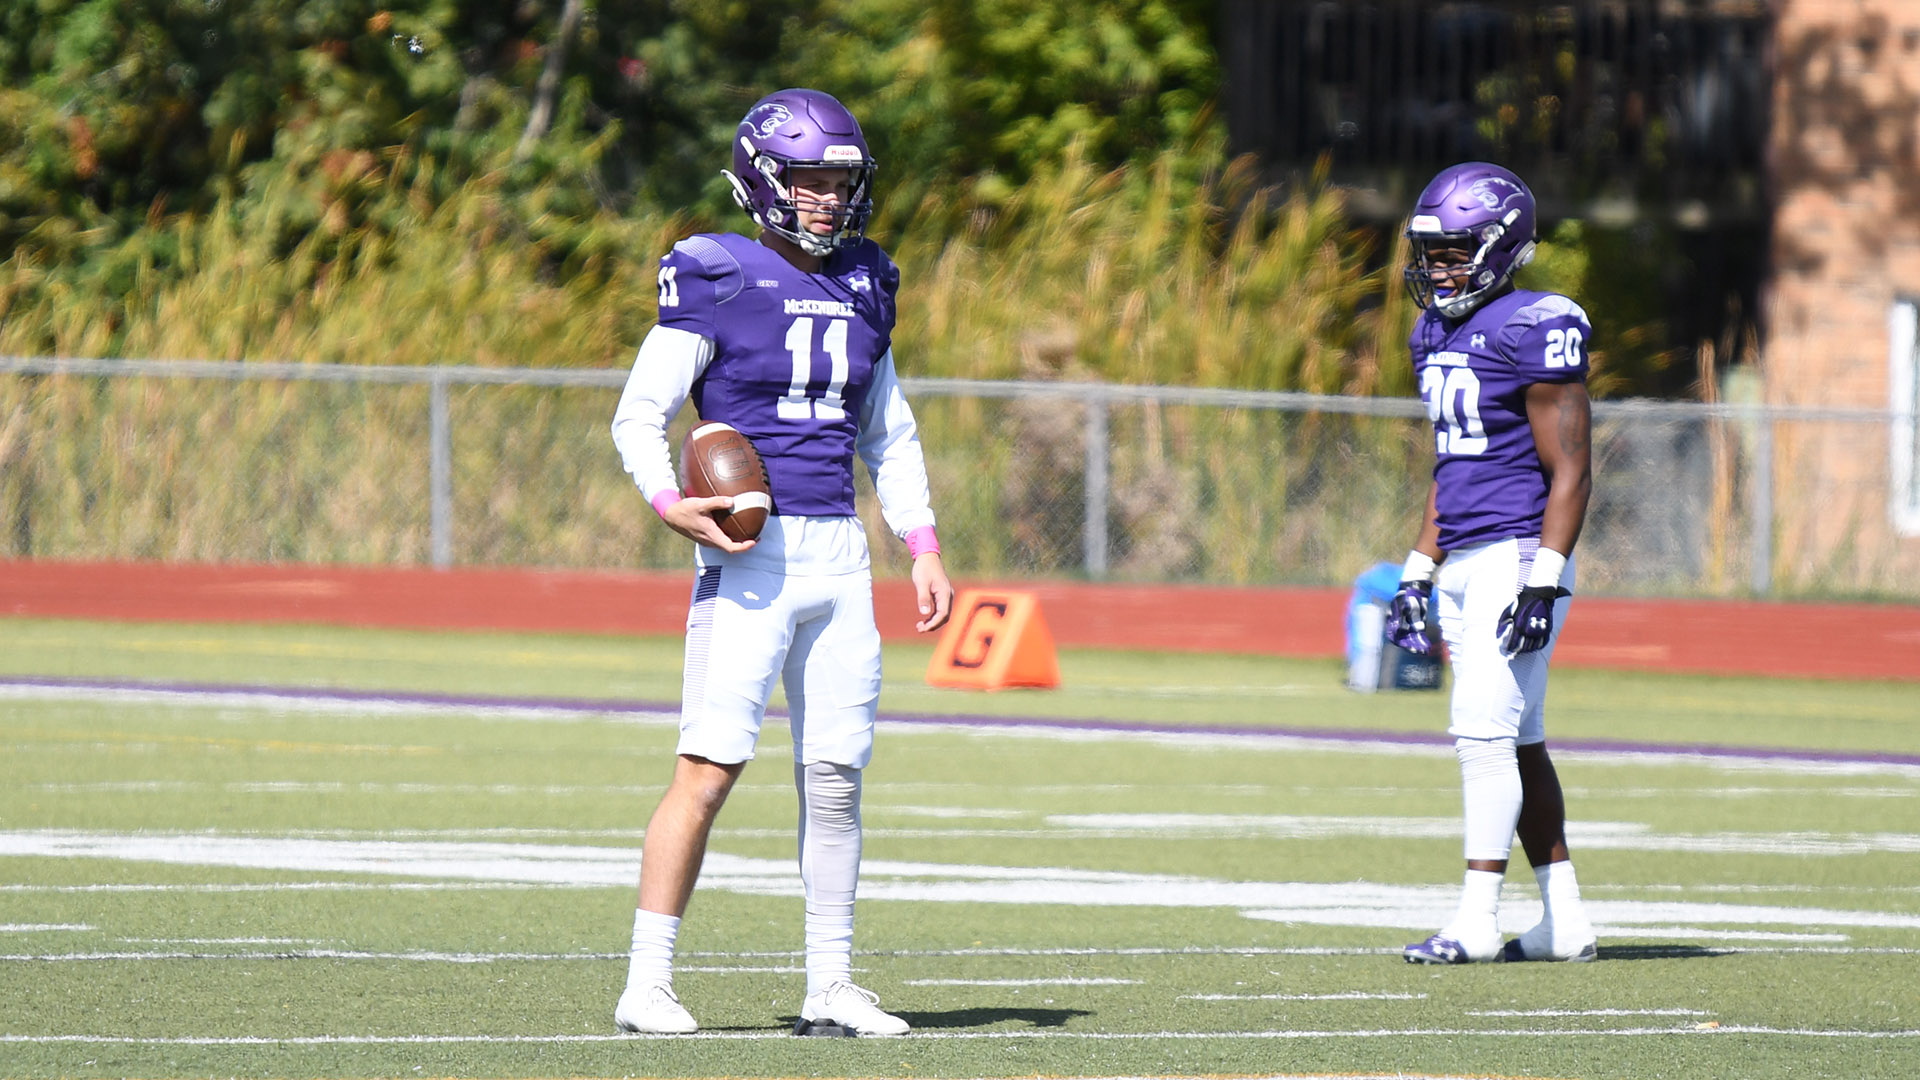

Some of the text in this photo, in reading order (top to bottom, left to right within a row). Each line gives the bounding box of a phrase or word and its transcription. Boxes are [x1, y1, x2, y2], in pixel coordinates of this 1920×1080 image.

[658, 266, 680, 307] 11
[776, 316, 849, 420] 11
[1545, 327, 1583, 369] 20
[1421, 366, 1489, 455] 20
[951, 601, 1008, 669] G
